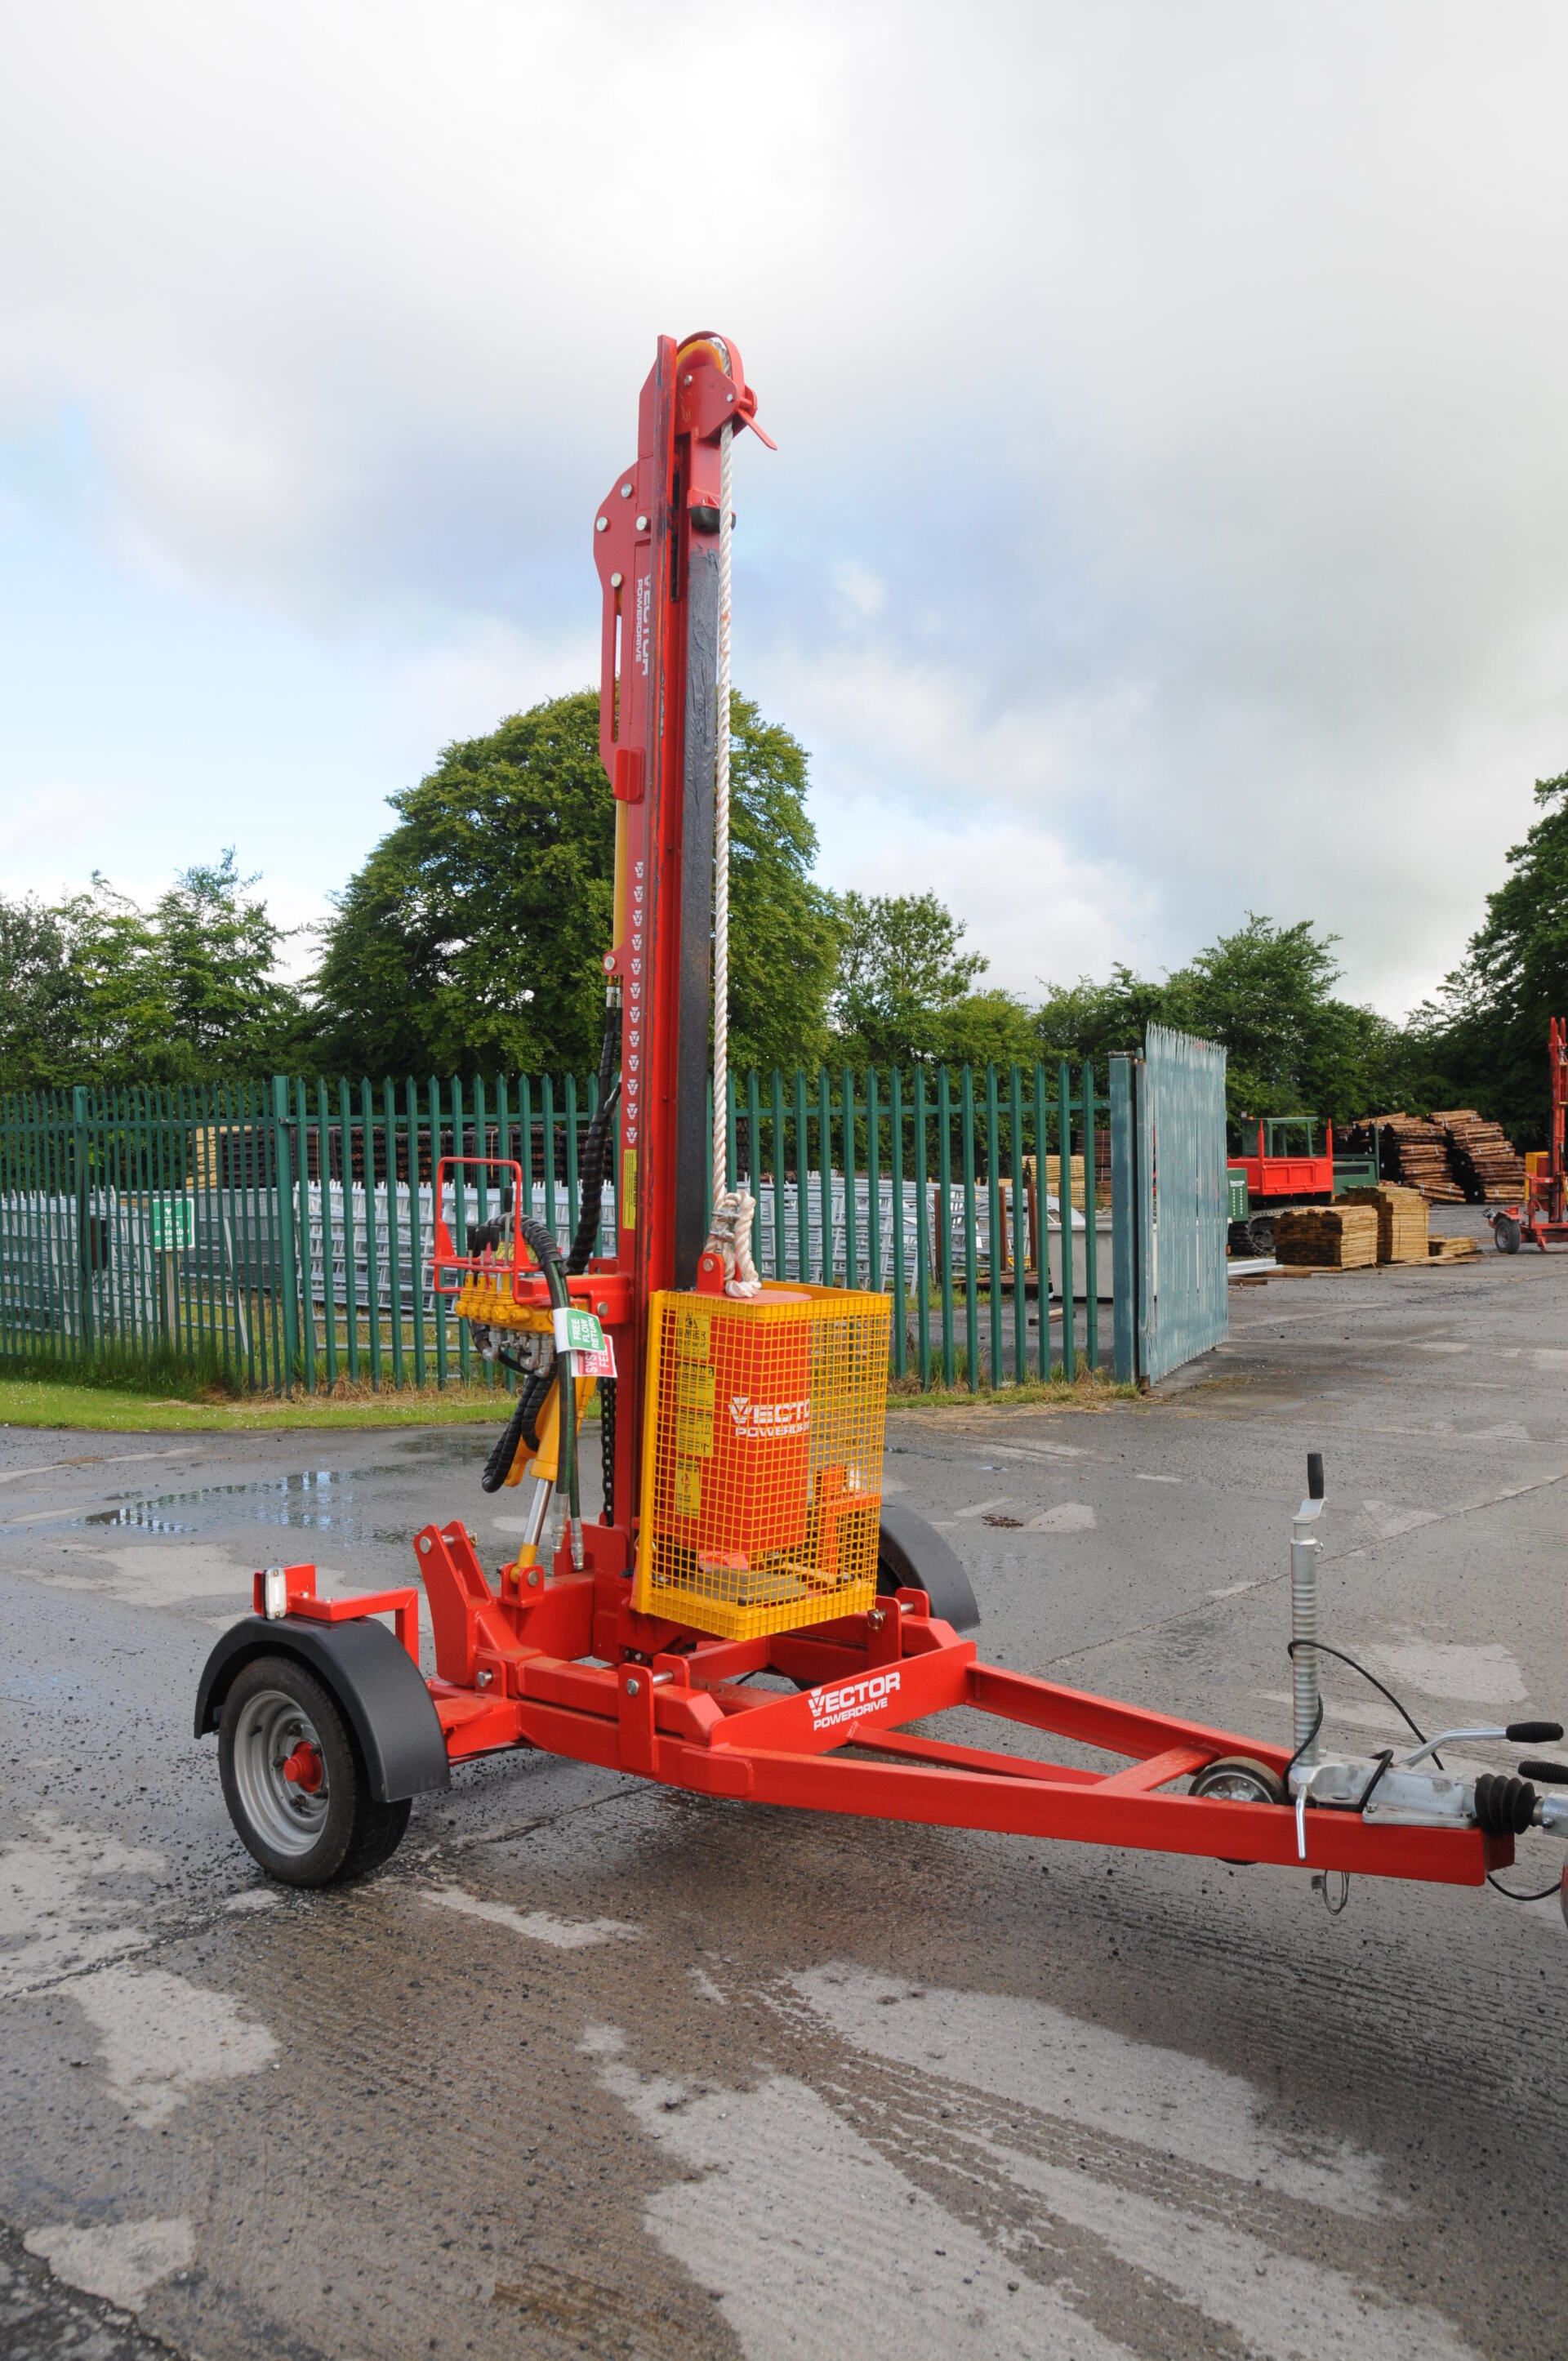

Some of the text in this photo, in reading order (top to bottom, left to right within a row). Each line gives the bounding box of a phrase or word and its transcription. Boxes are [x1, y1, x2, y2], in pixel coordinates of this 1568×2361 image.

[165, 1219, 180, 1227] Fie
[164, 1236, 184, 1245] pont
[571, 1317, 581, 1340] FREE
[580, 1318, 590, 1343] FLOW
[588, 1316, 600, 1349] RETURN
[808, 1671, 901, 1717] VECTOR
[813, 1697, 888, 1731] POWERDRIVE
